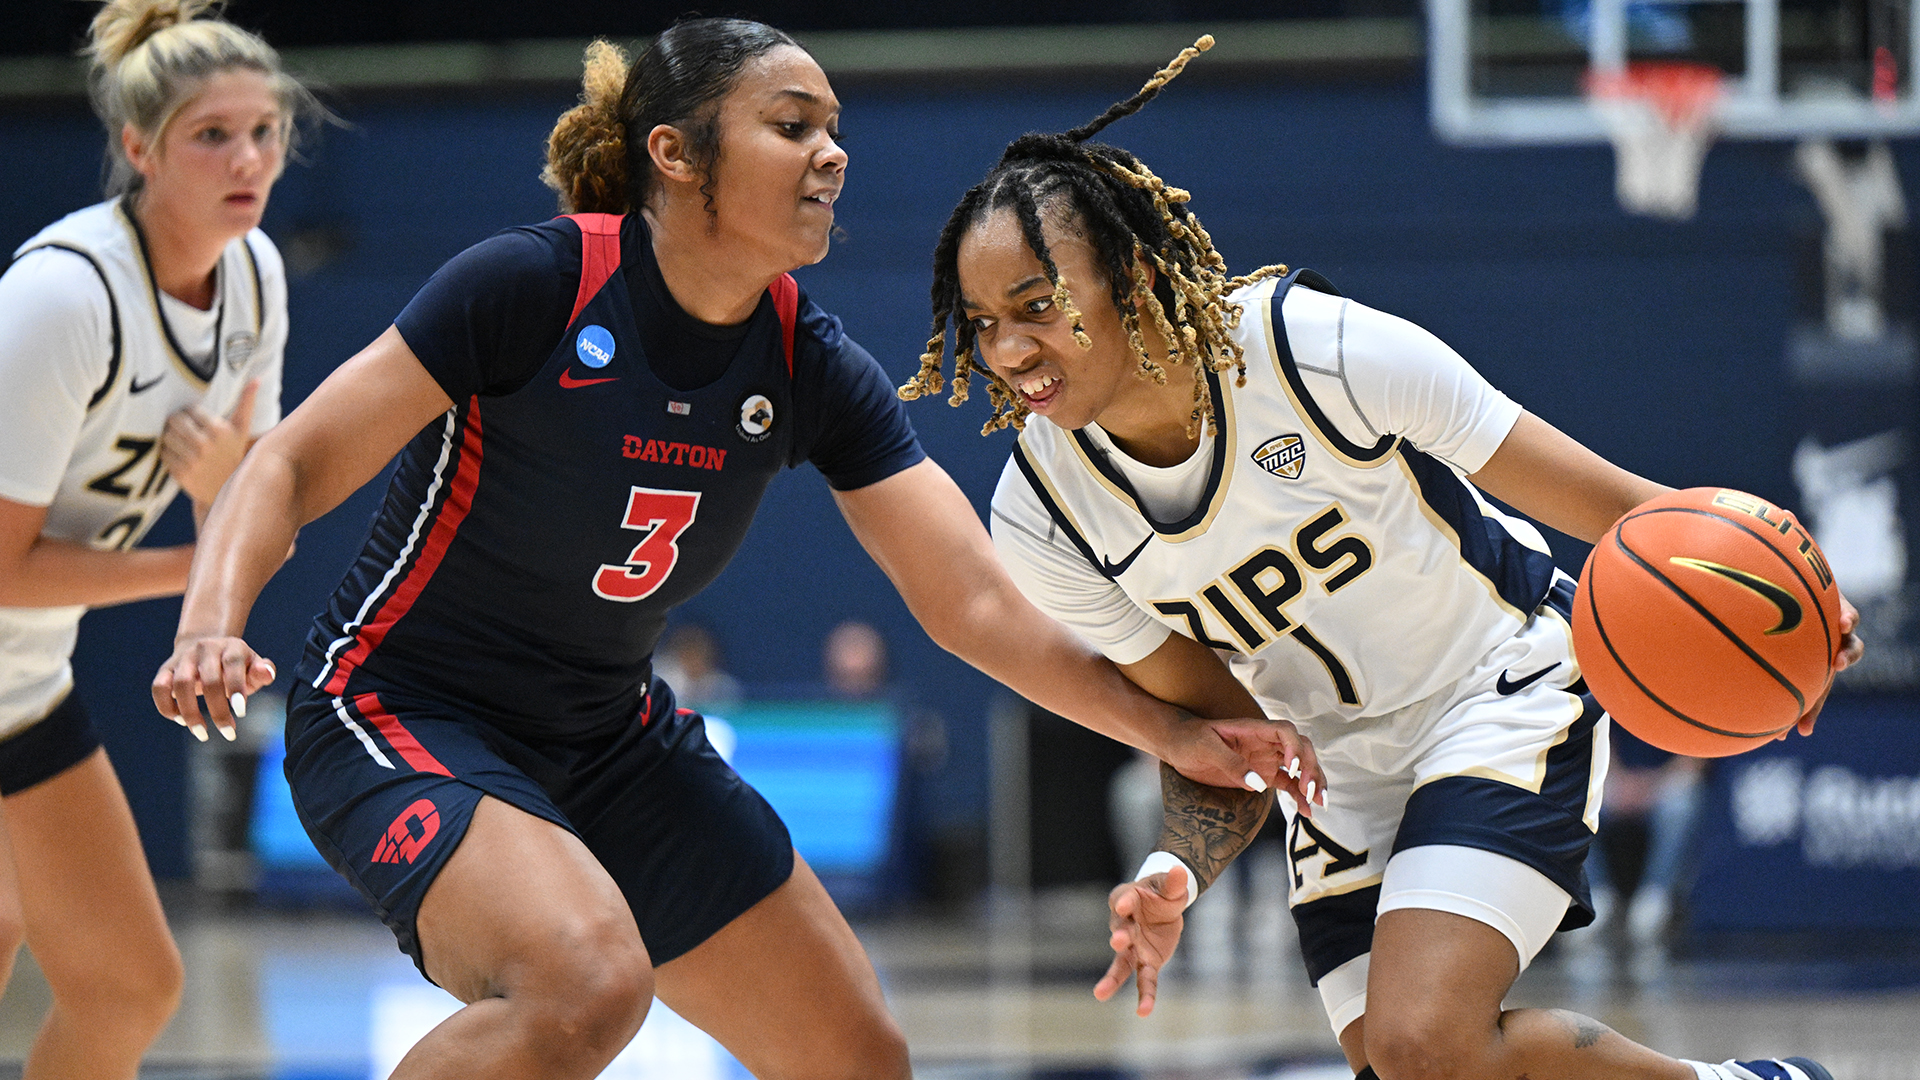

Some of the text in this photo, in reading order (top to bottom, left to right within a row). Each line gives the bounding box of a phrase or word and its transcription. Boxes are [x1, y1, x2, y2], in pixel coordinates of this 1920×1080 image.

[580, 338, 610, 364] NCAA
[622, 434, 727, 471] DAYTON
[1260, 443, 1306, 472] MAC
[592, 485, 702, 603] 3
[1148, 500, 1376, 656] ZIPS
[1711, 488, 1833, 592] ELITE
[1288, 622, 1363, 707] 1
[1288, 811, 1370, 891] A
